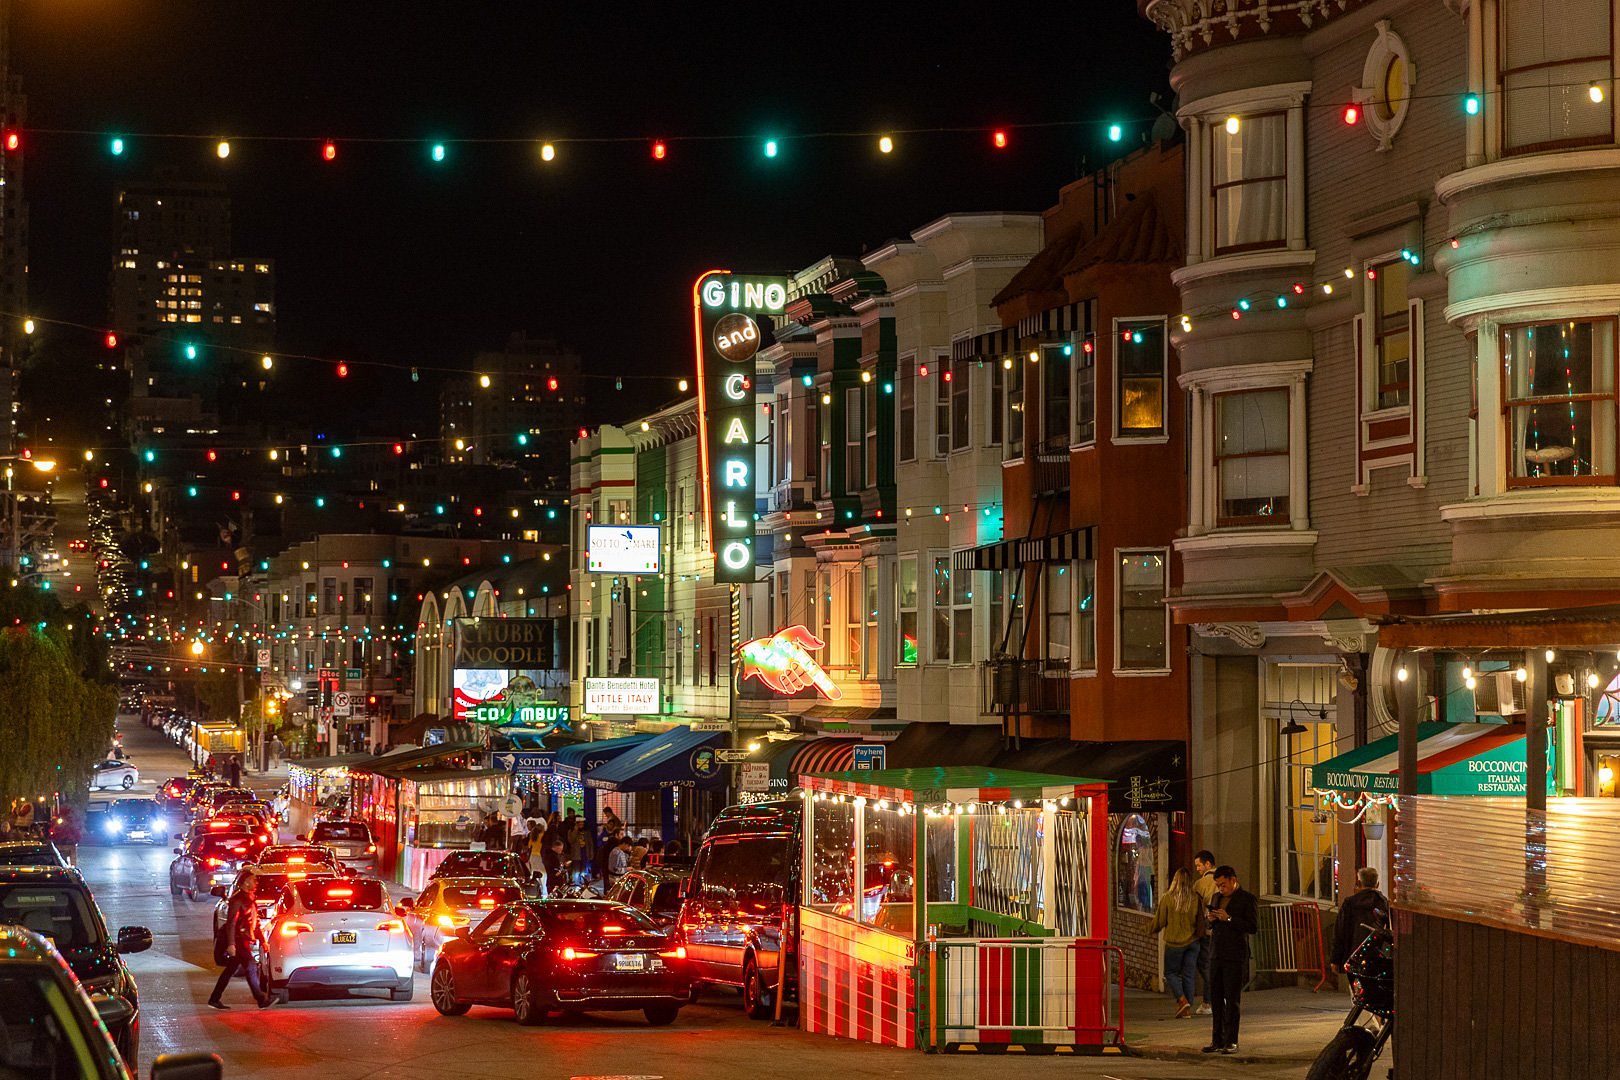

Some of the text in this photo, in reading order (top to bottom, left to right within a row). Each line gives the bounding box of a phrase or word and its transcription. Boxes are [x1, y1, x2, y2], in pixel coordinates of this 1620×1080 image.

[703, 281, 786, 310] GINO
[718, 317, 757, 349] and
[723, 373, 750, 570] CARLO
[591, 539, 620, 549] SOTTO
[460, 623, 546, 643] CHUBBY
[460, 646, 546, 663] NOODLE
[586, 681, 656, 690] Dante Benedetti Hotel
[591, 694, 653, 703] LITTLE ITALY
[476, 707, 569, 721] COMBUS
[698, 722, 724, 732] Jasper
[856, 747, 883, 757] Pay here
[518, 757, 551, 767] SOTTO
[1468, 761, 1528, 773] BOCCONCIN
[768, 779, 788, 787] GINO
[1327, 772, 1369, 789] BOCCONCINO
[1488, 775, 1520, 783] ITALIAN
